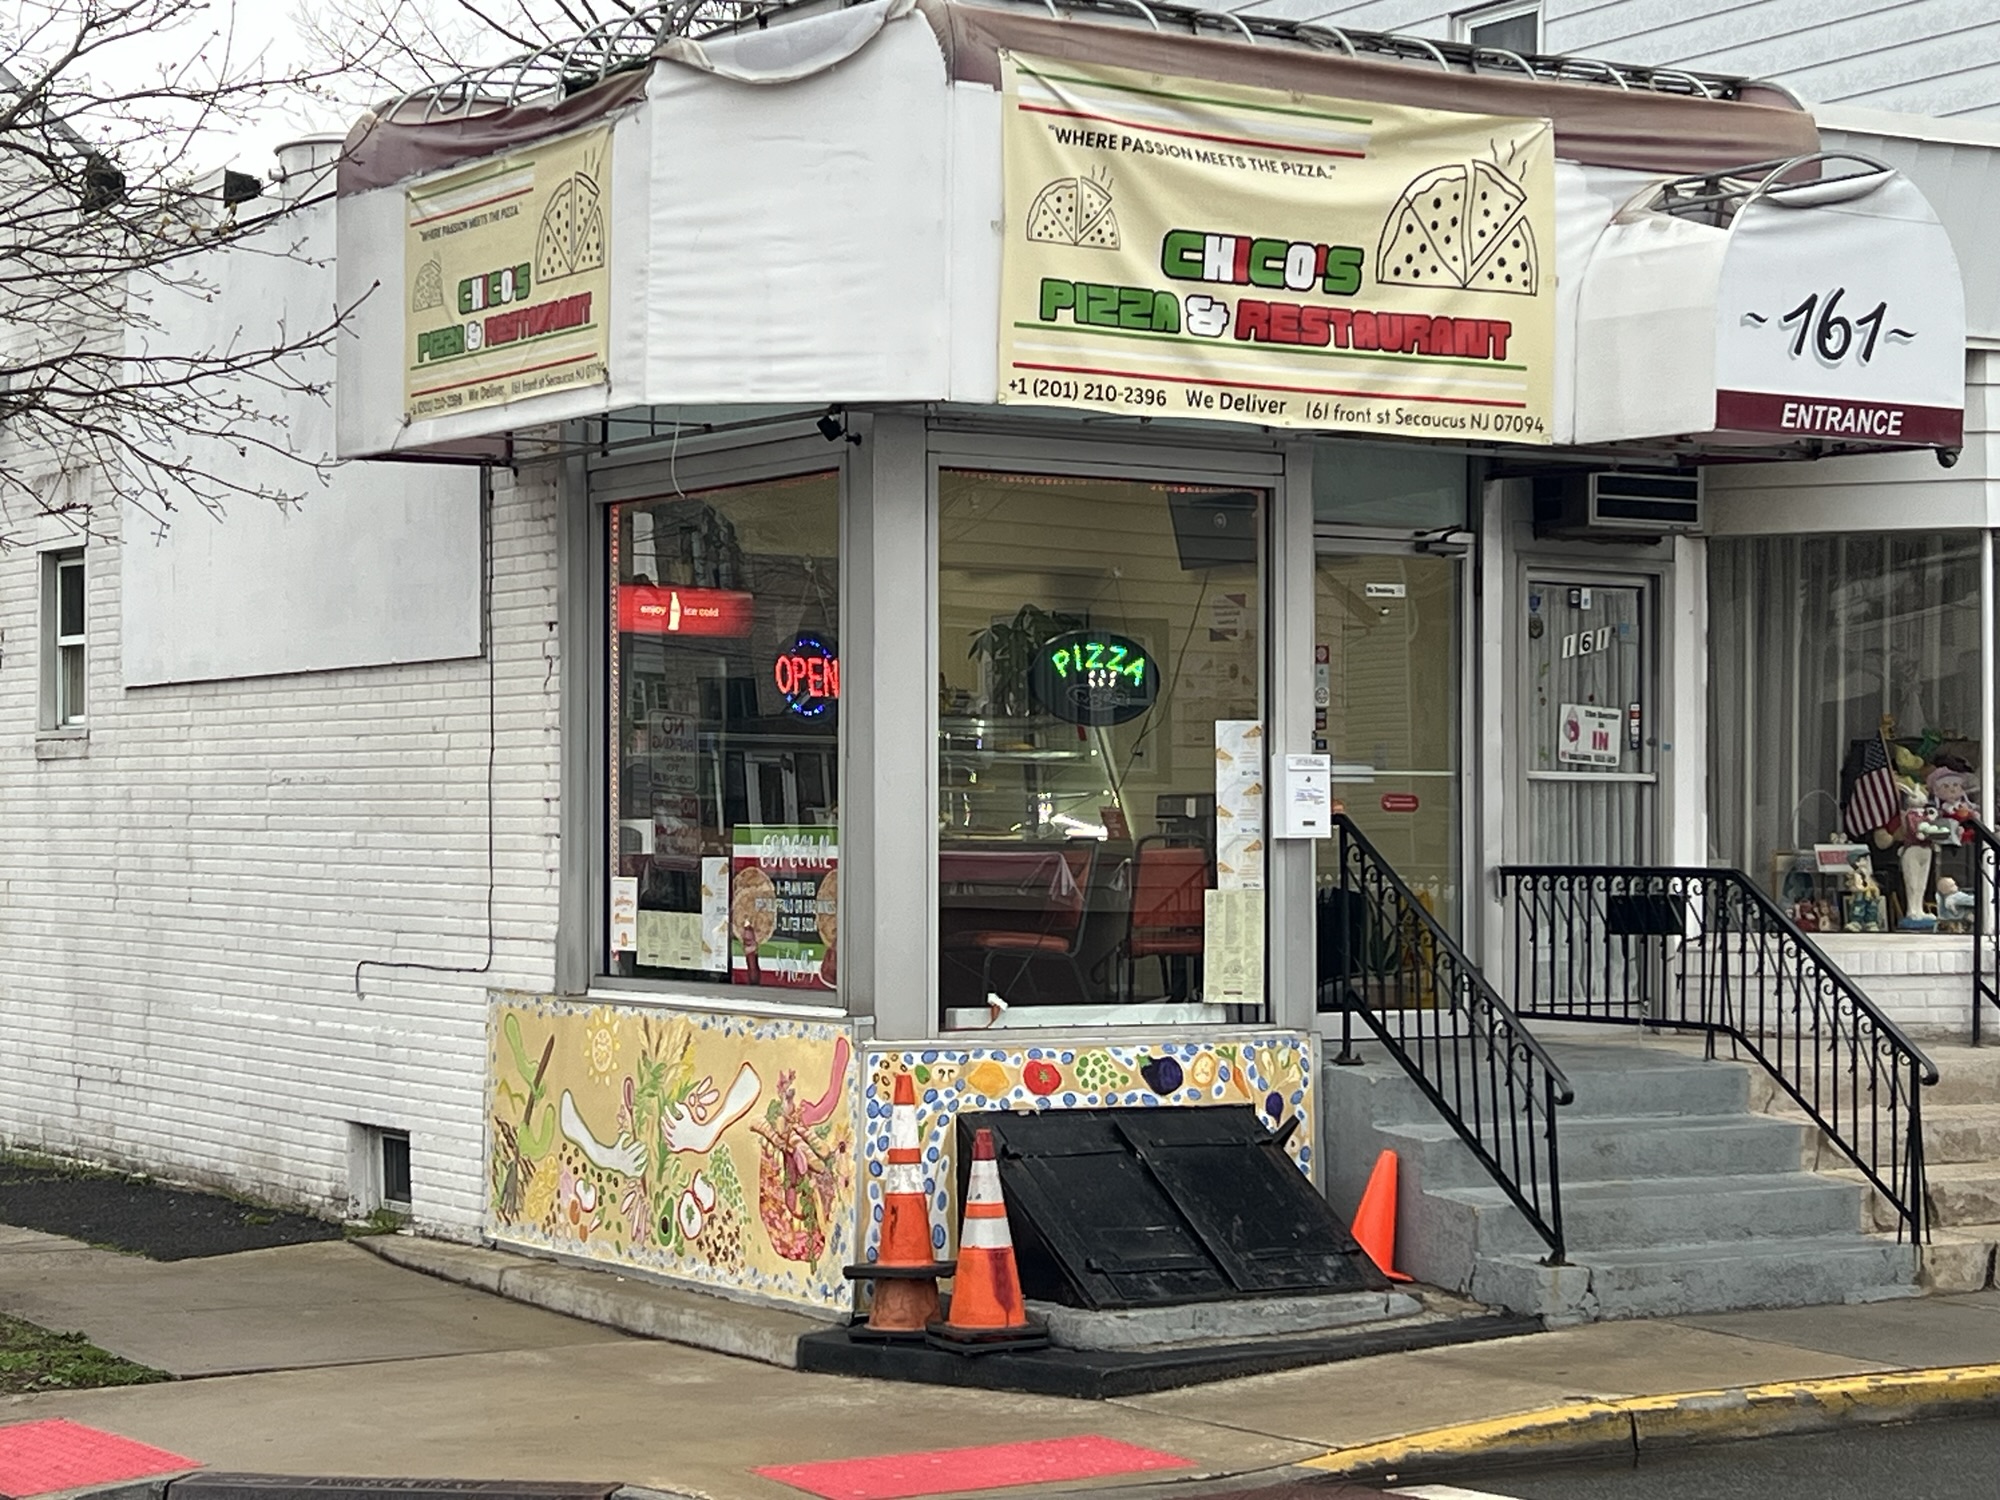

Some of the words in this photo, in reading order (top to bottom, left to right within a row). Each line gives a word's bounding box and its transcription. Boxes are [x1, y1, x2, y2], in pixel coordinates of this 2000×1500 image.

[1121, 136, 1193, 160] PASSION
[1195, 150, 1246, 169] MEETS
[1248, 157, 1278, 173] THE
[1161, 229, 1364, 296] CHICO'S
[418, 324, 465, 363] PIZZA
[466, 320, 483, 351] &
[484, 291, 592, 347] RESTAURANT
[1039, 277, 1180, 333] PIZZA
[1186, 295, 1229, 338] &
[1234, 298, 1512, 361] RESTAURANT
[1779, 287, 1888, 364] 161
[1008, 377, 1028, 395] +1
[1032, 379, 1078, 400] (201)
[1083, 383, 1167, 407] 210-2396
[1185, 389, 1214, 409] We
[1219, 391, 1287, 415] Deliver
[1305, 401, 1329, 420] 161
[1333, 403, 1371, 423] front
[1376, 408, 1391, 424] st
[1395, 407, 1466, 429] Secaucus
[1470, 413, 1489, 429] NJ
[1493, 414, 1544, 434] 07094
[1781, 402, 1904, 436] ENTRANCE
[640, 605, 666, 616] enjoy
[684, 605, 697, 616] ice
[699, 607, 719, 617] cold
[1052, 643, 1144, 686] PIZZA
[1563, 628, 1610, 658] 161
[775, 655, 840, 699] OPEN
[1592, 731, 1609, 751] IN
